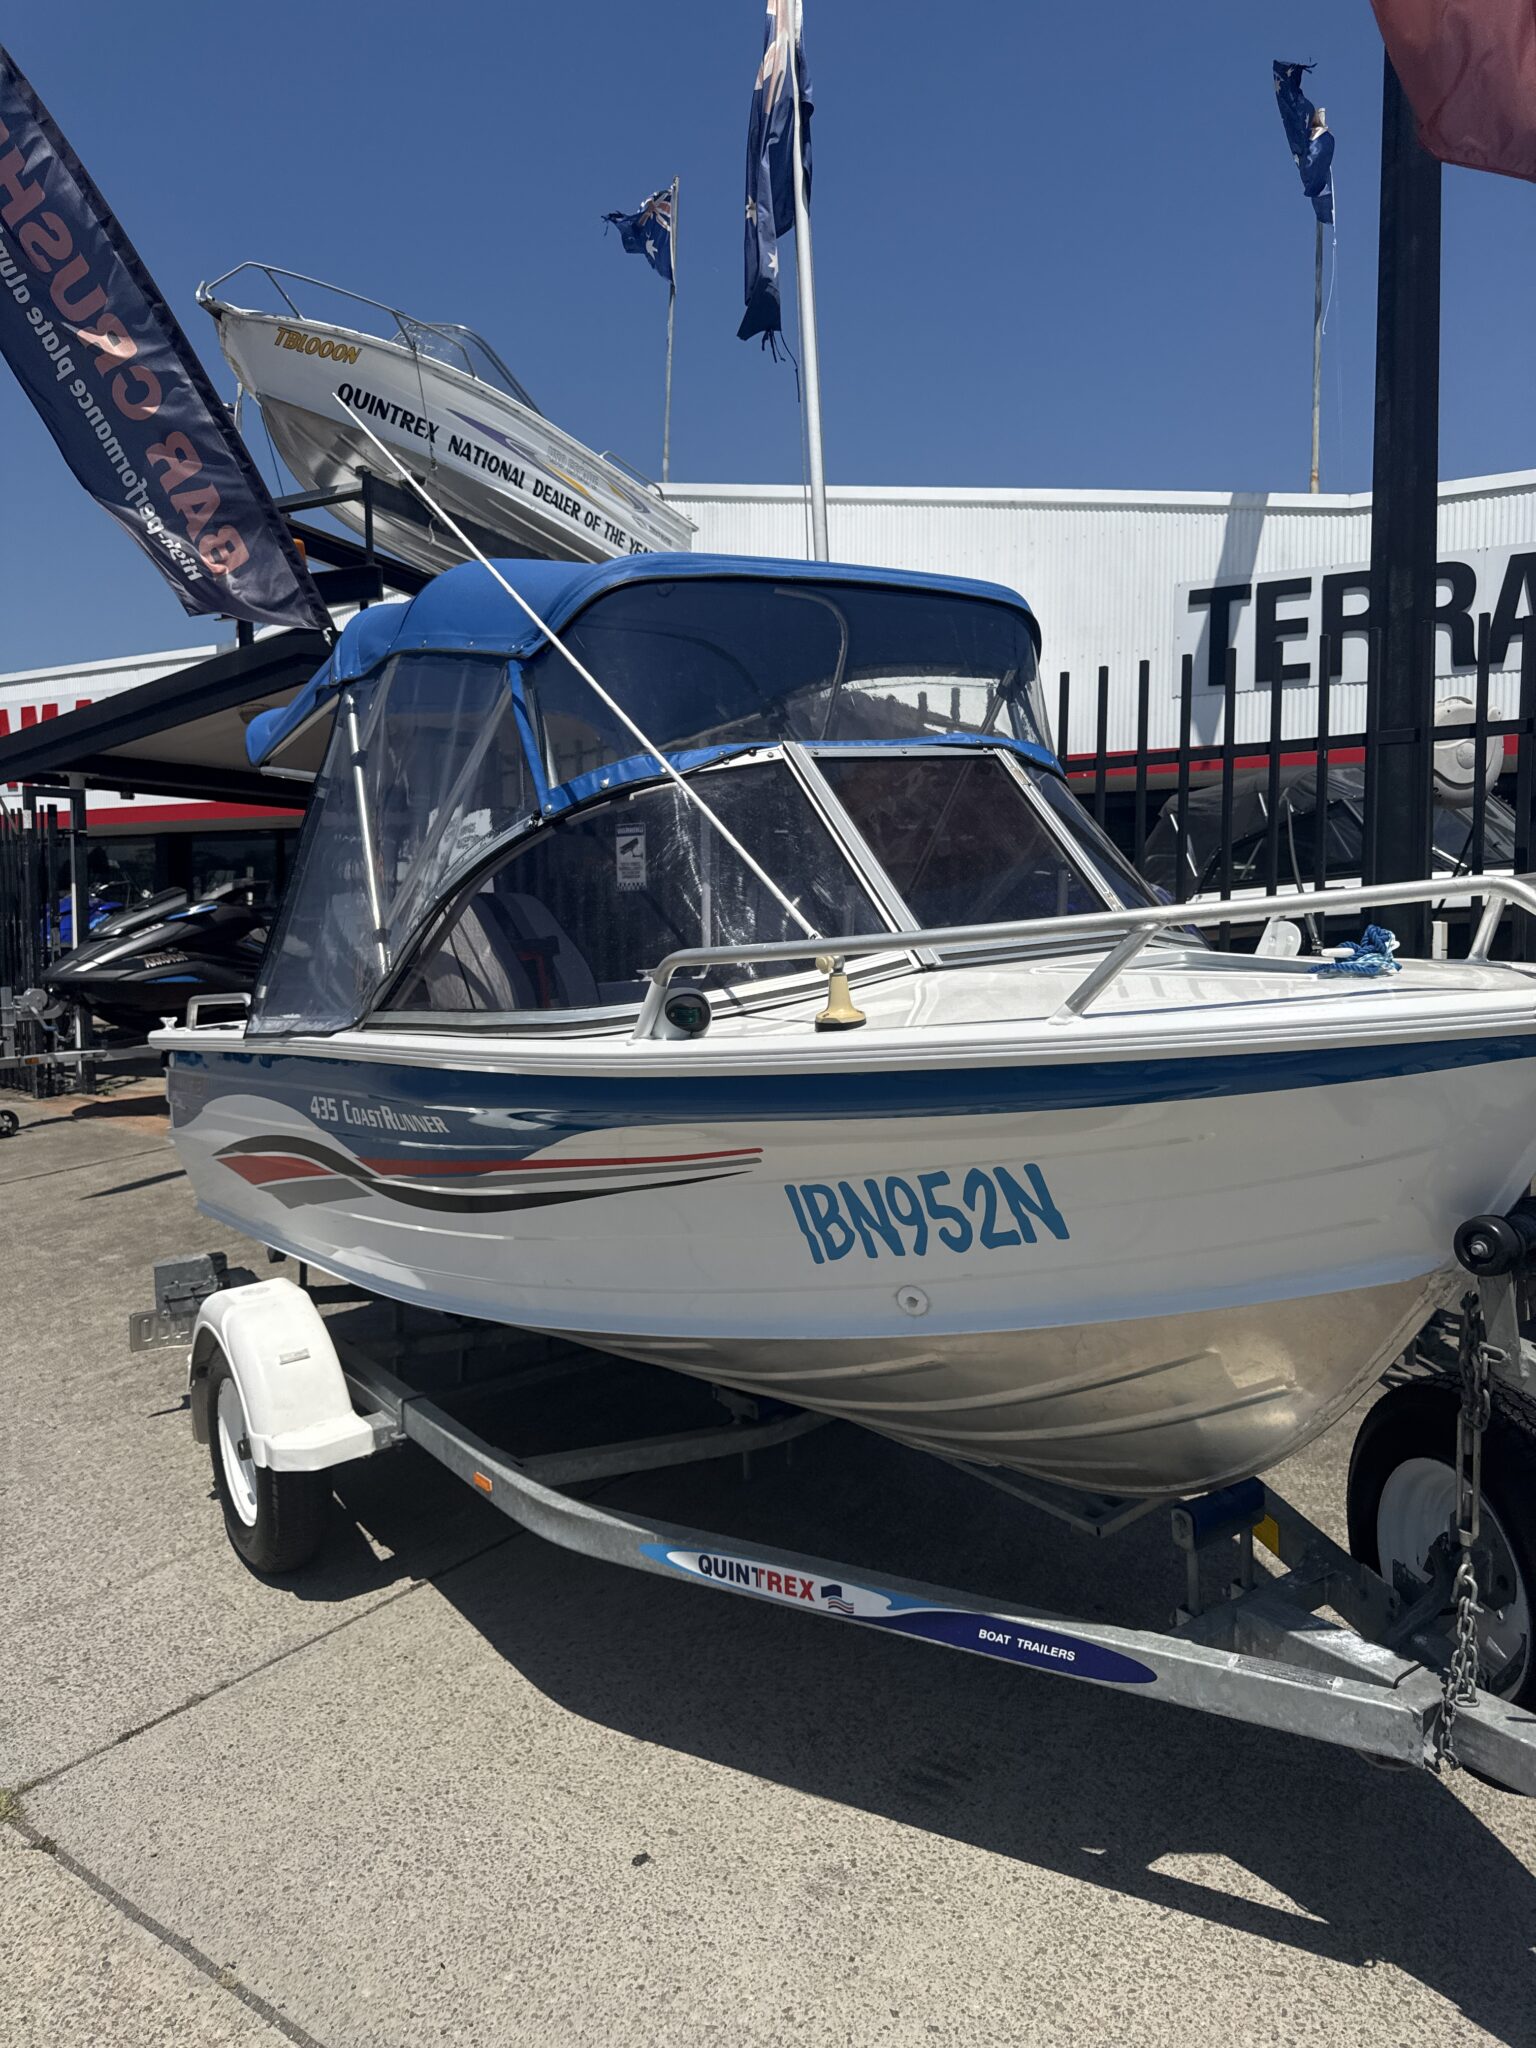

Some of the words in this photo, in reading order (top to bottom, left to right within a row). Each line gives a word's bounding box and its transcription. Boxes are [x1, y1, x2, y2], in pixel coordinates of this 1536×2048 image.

[337, 382, 440, 444] QUINTREX
[448, 434, 525, 490] NATIONAL
[532, 478, 581, 521] DEALER
[584, 511, 602, 532] OF
[604, 521, 626, 549] THE
[629, 537, 653, 554] YE
[310, 1095, 339, 1122] 435
[342, 1099, 450, 1134] COASTRUNNER
[784, 1163, 1070, 1264] IBN952N
[698, 1554, 815, 1602] QUINTREX
[978, 1628, 1012, 1645] BOAT
[1016, 1638, 1076, 1662] TRAILERS
